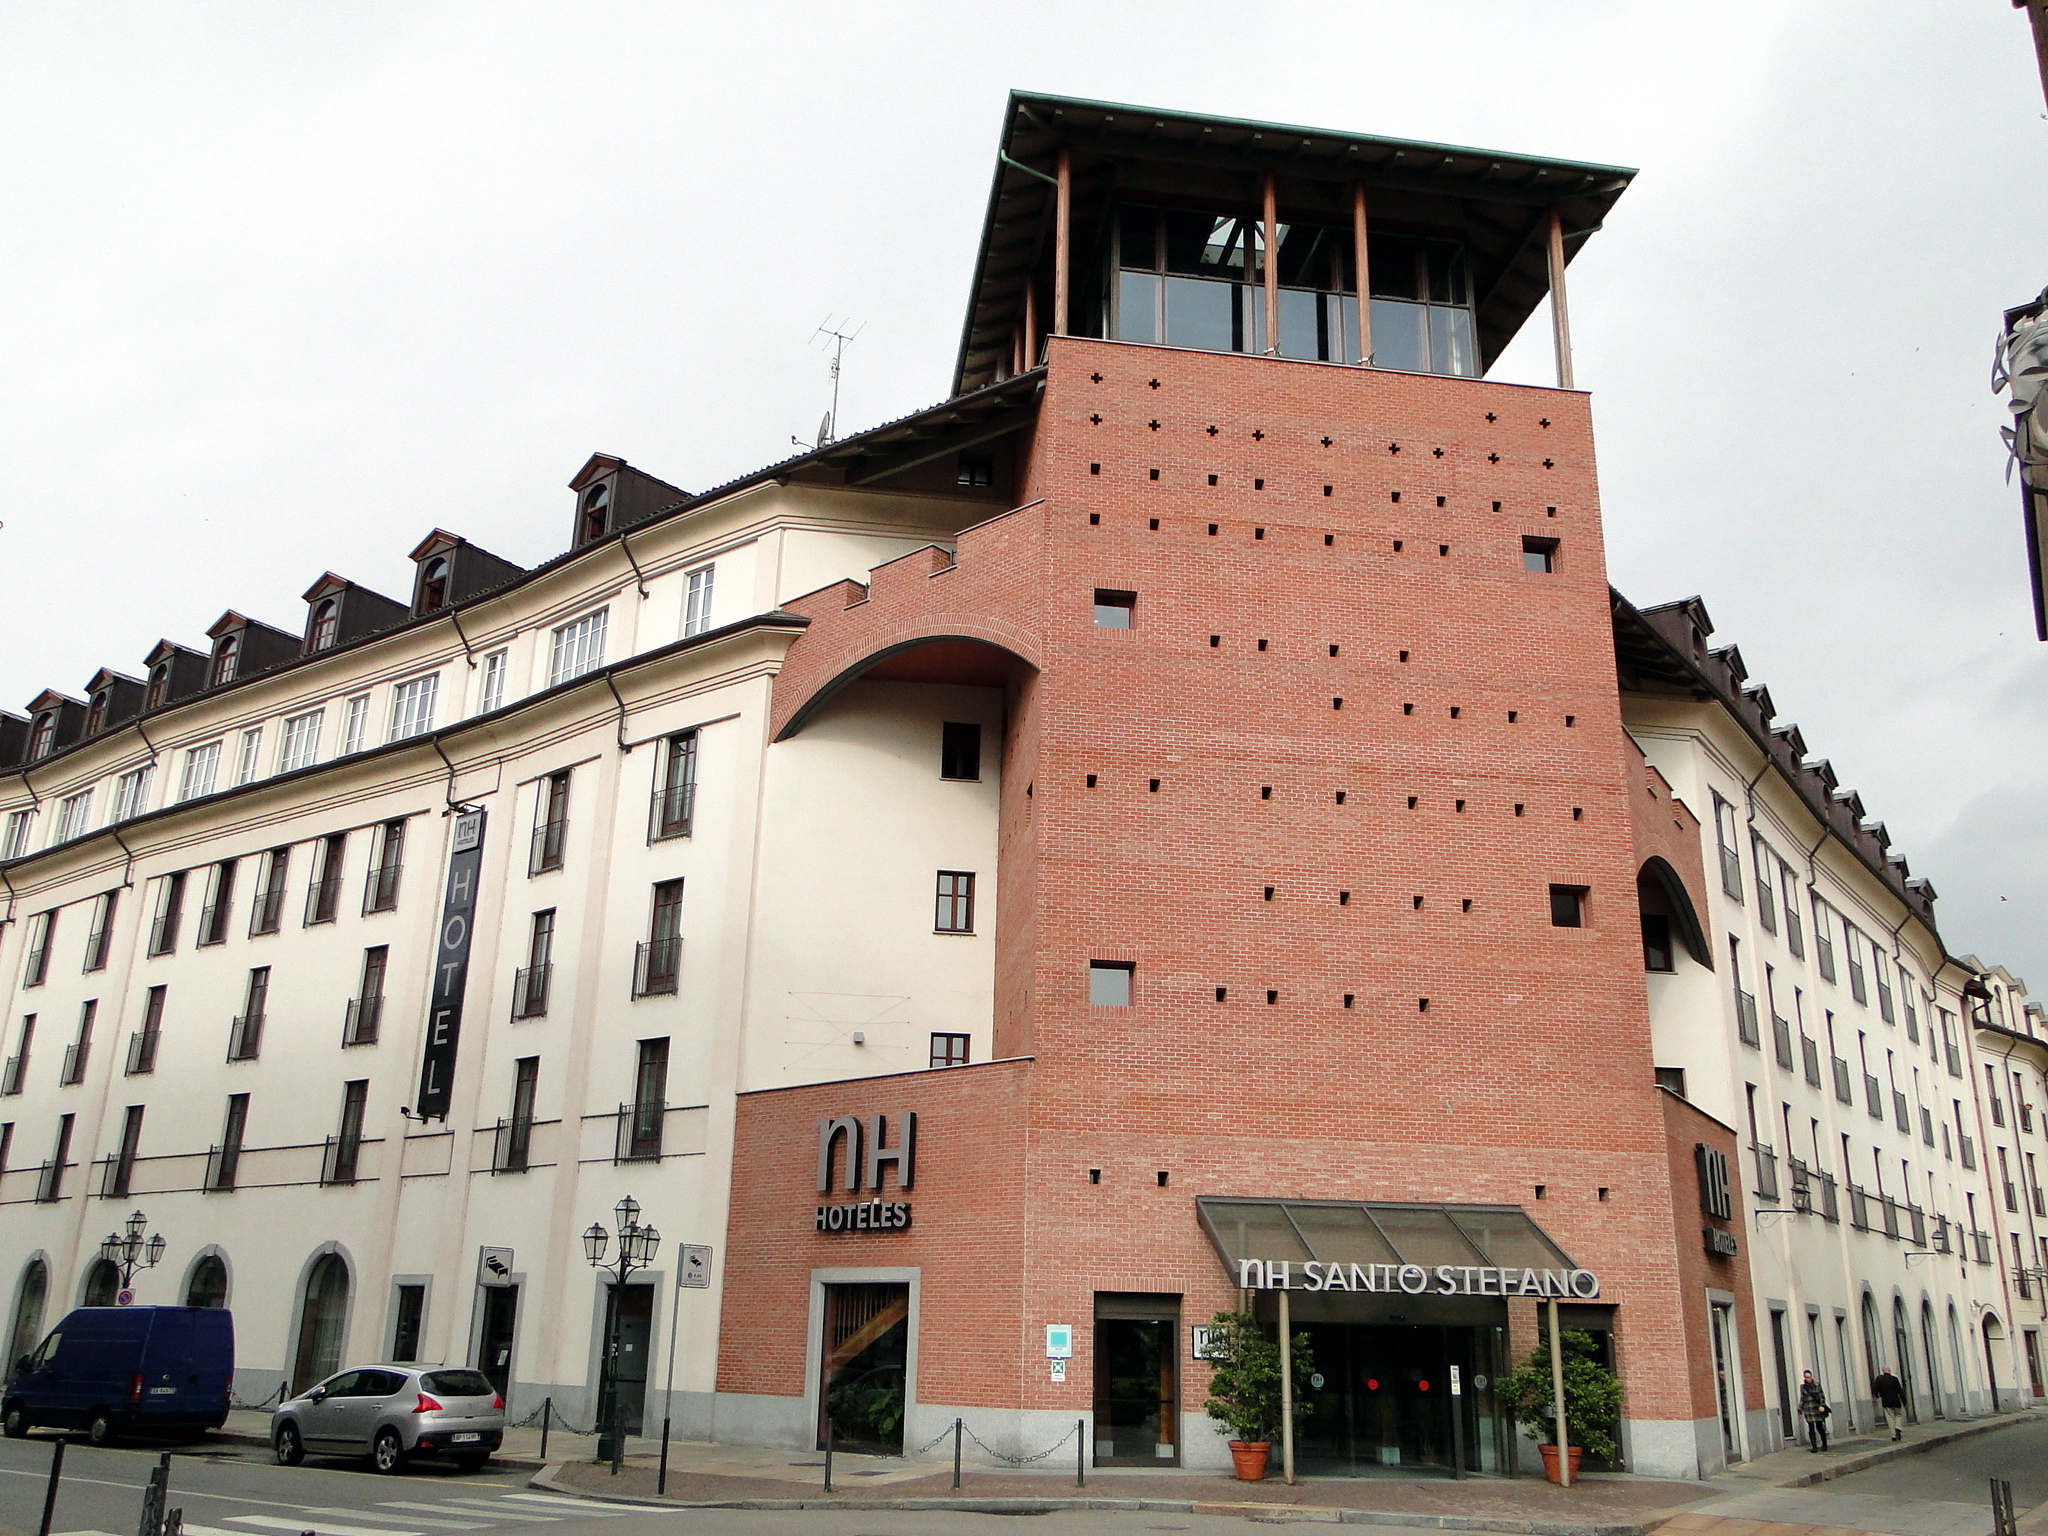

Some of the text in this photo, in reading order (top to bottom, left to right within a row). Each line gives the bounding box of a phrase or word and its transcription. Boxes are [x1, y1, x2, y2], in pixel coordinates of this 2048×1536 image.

[427, 868, 471, 1095] HOTEL
[815, 1202, 911, 1232] HOTELES
[1303, 1260, 1428, 1294] SANTO
[1436, 1264, 1599, 1299] STEFANO
